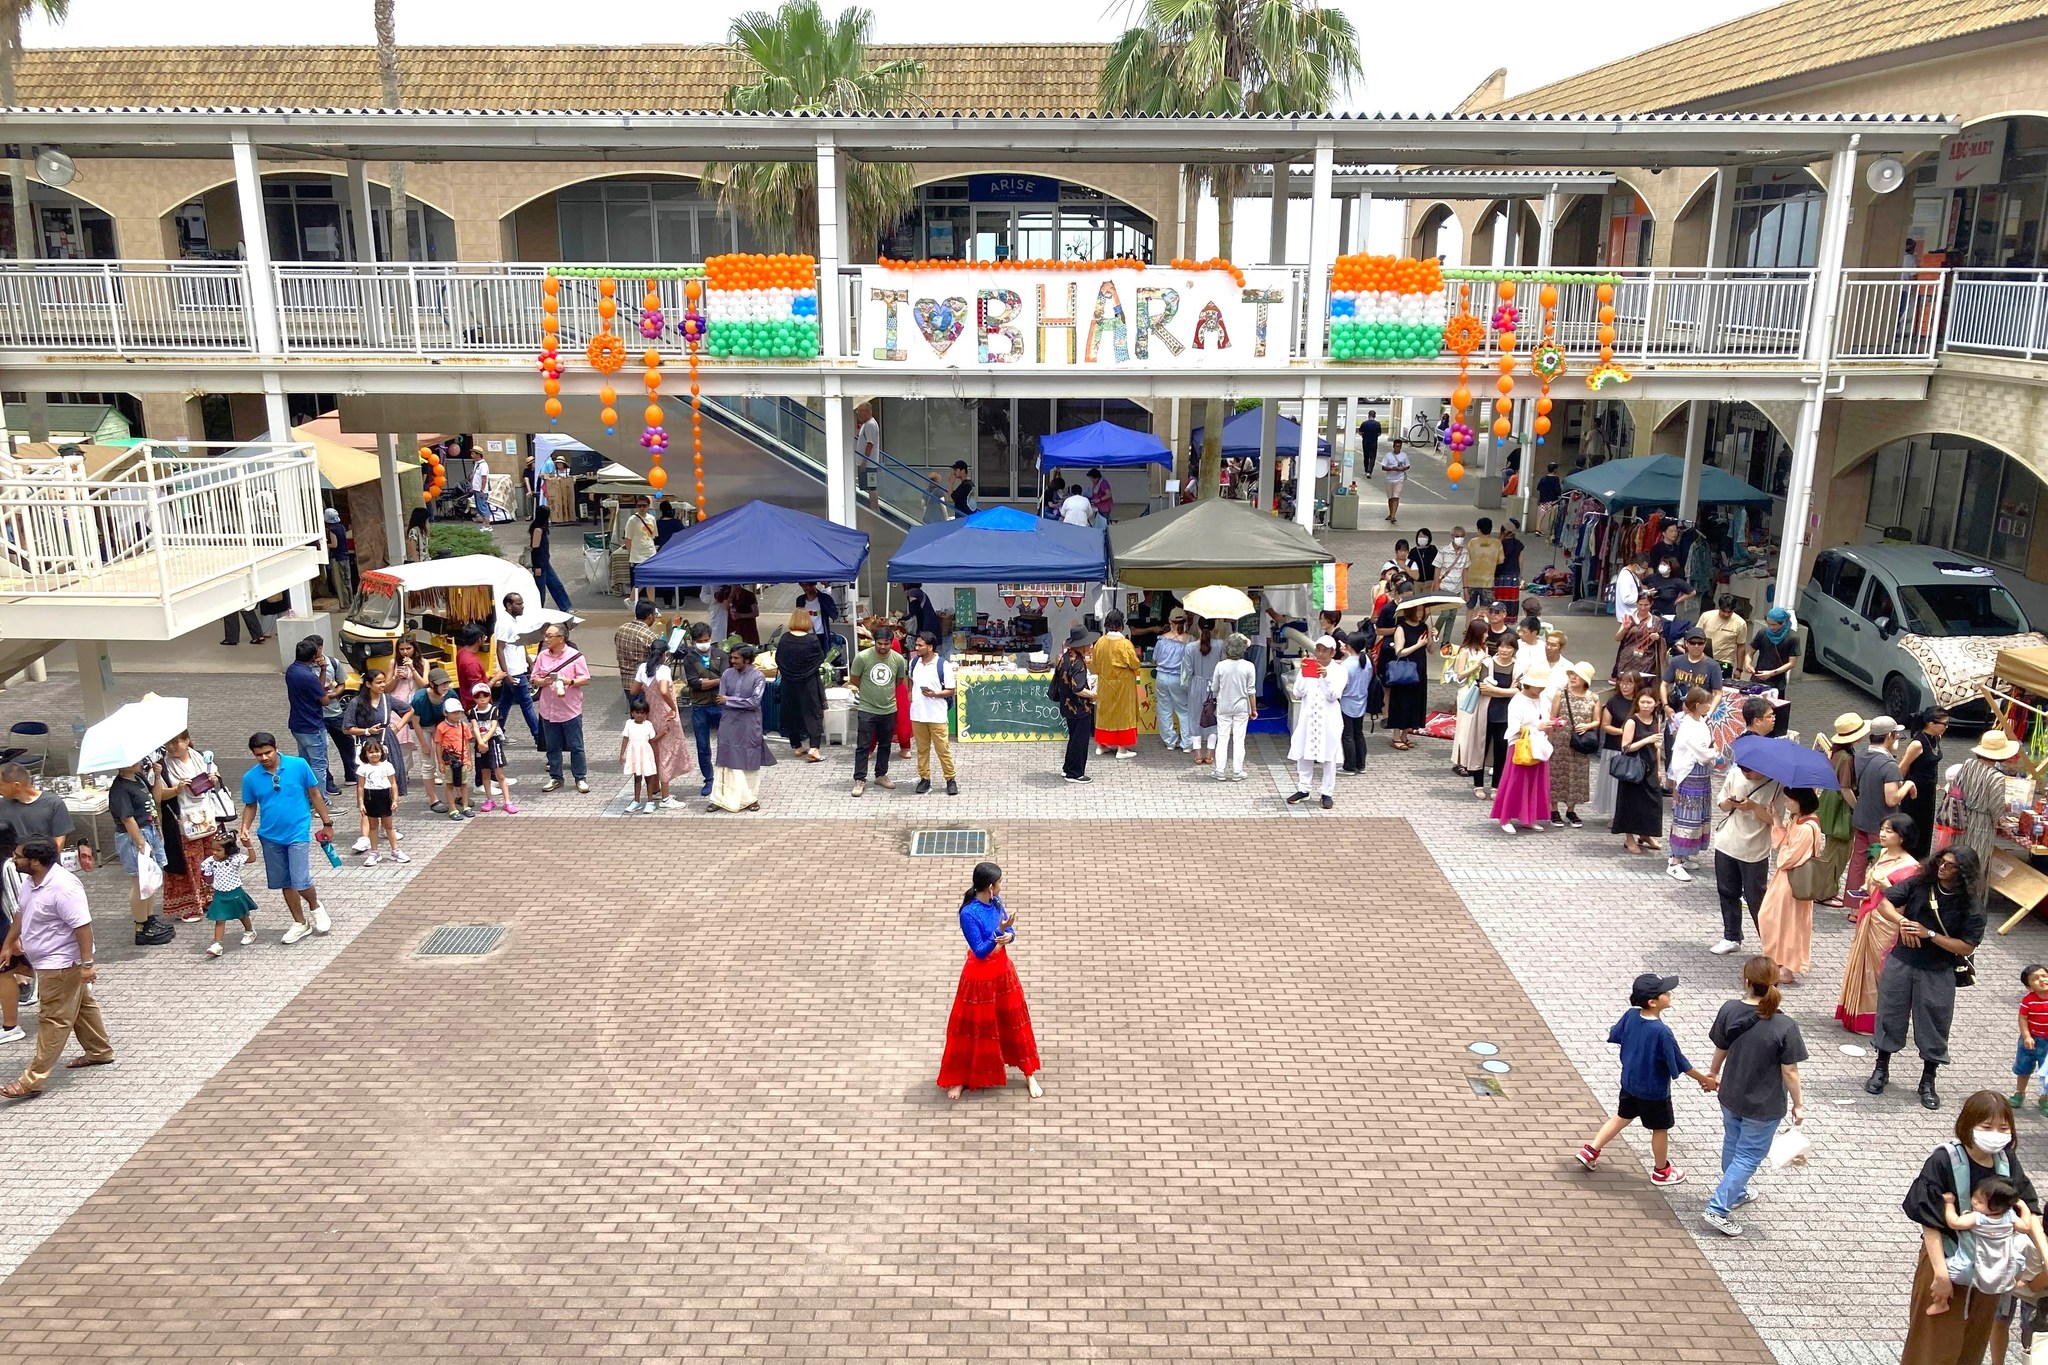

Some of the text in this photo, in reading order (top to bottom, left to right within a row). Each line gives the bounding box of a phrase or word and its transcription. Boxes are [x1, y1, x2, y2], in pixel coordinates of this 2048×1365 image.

[1948, 140, 1994, 160] ABC-MART
[991, 178, 1036, 193] ARISE
[870, 280, 1284, 364] I BHARAT
